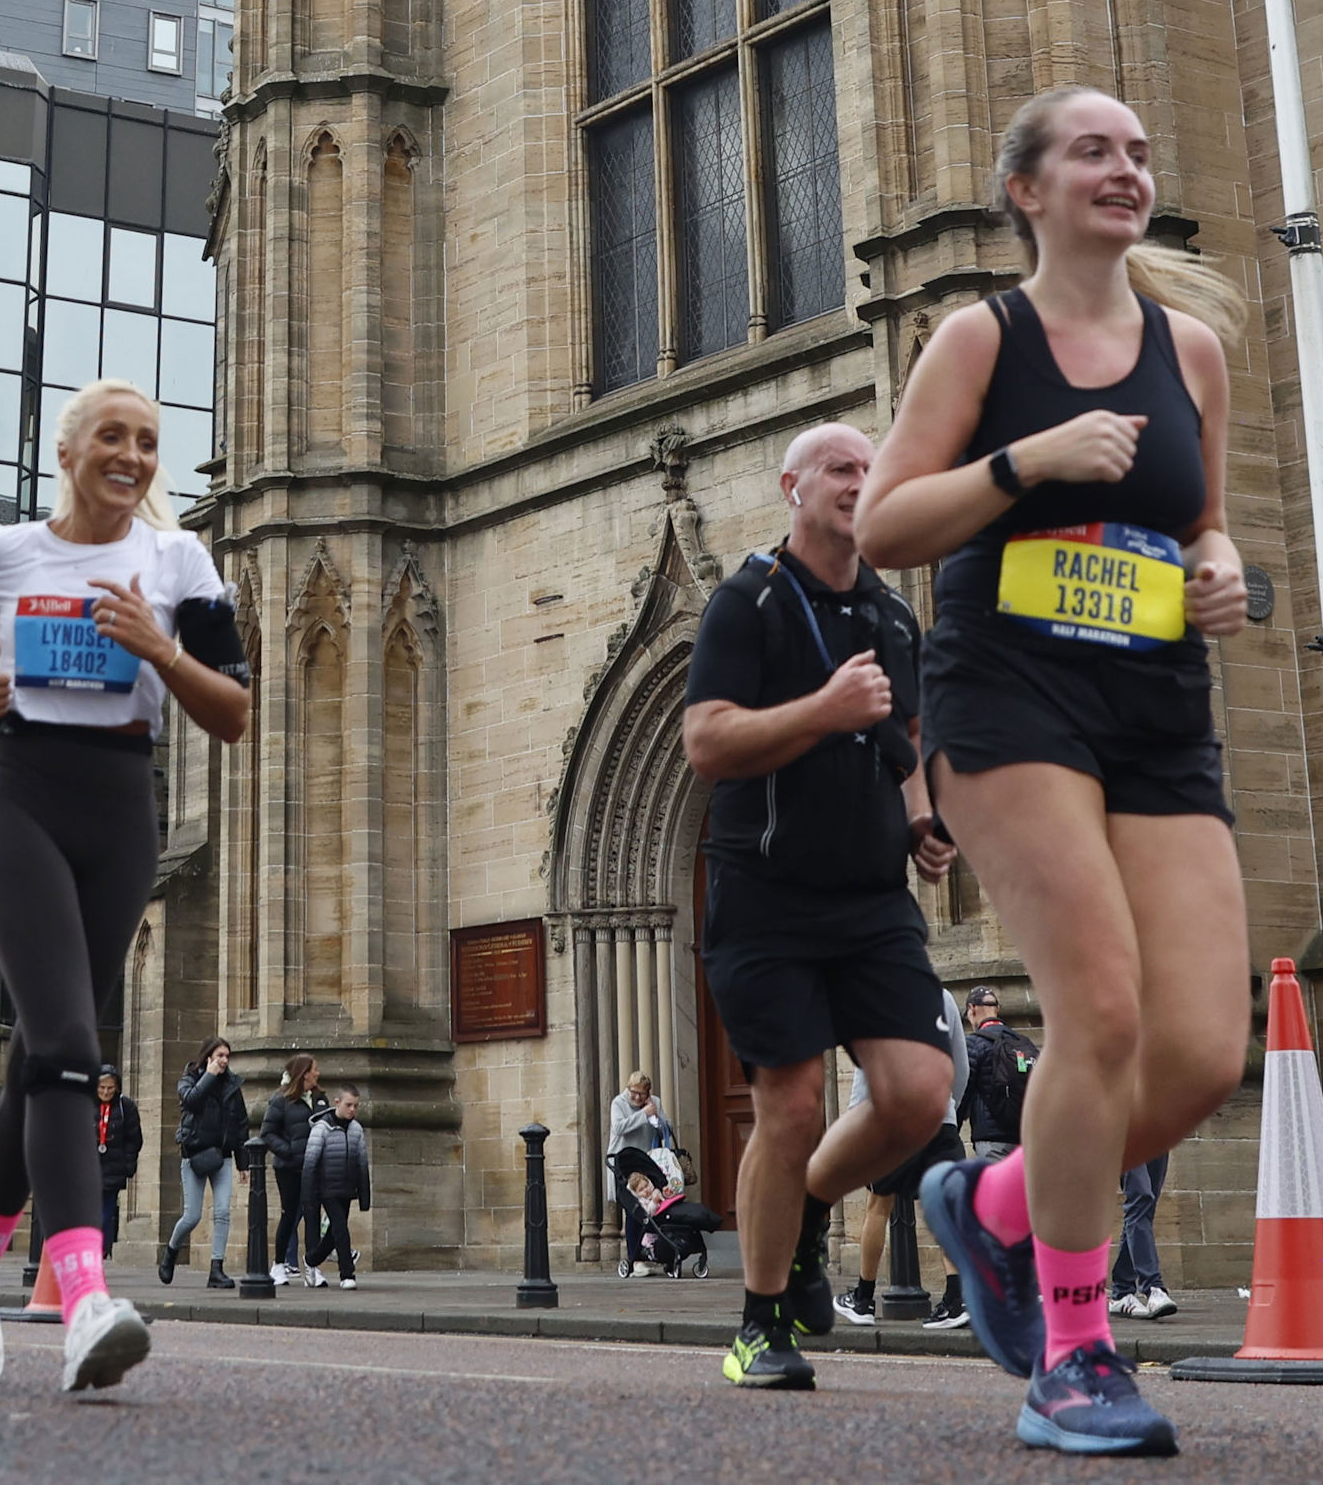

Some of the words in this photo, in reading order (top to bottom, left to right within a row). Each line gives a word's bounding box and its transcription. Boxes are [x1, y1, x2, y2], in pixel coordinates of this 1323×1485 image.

[1053, 548, 1140, 592] RACHEL
[1054, 580, 1134, 625] 13318
[1052, 623, 1078, 638] HALF
[1077, 626, 1131, 646] MARATHON
[48, 649, 108, 674] 18402
